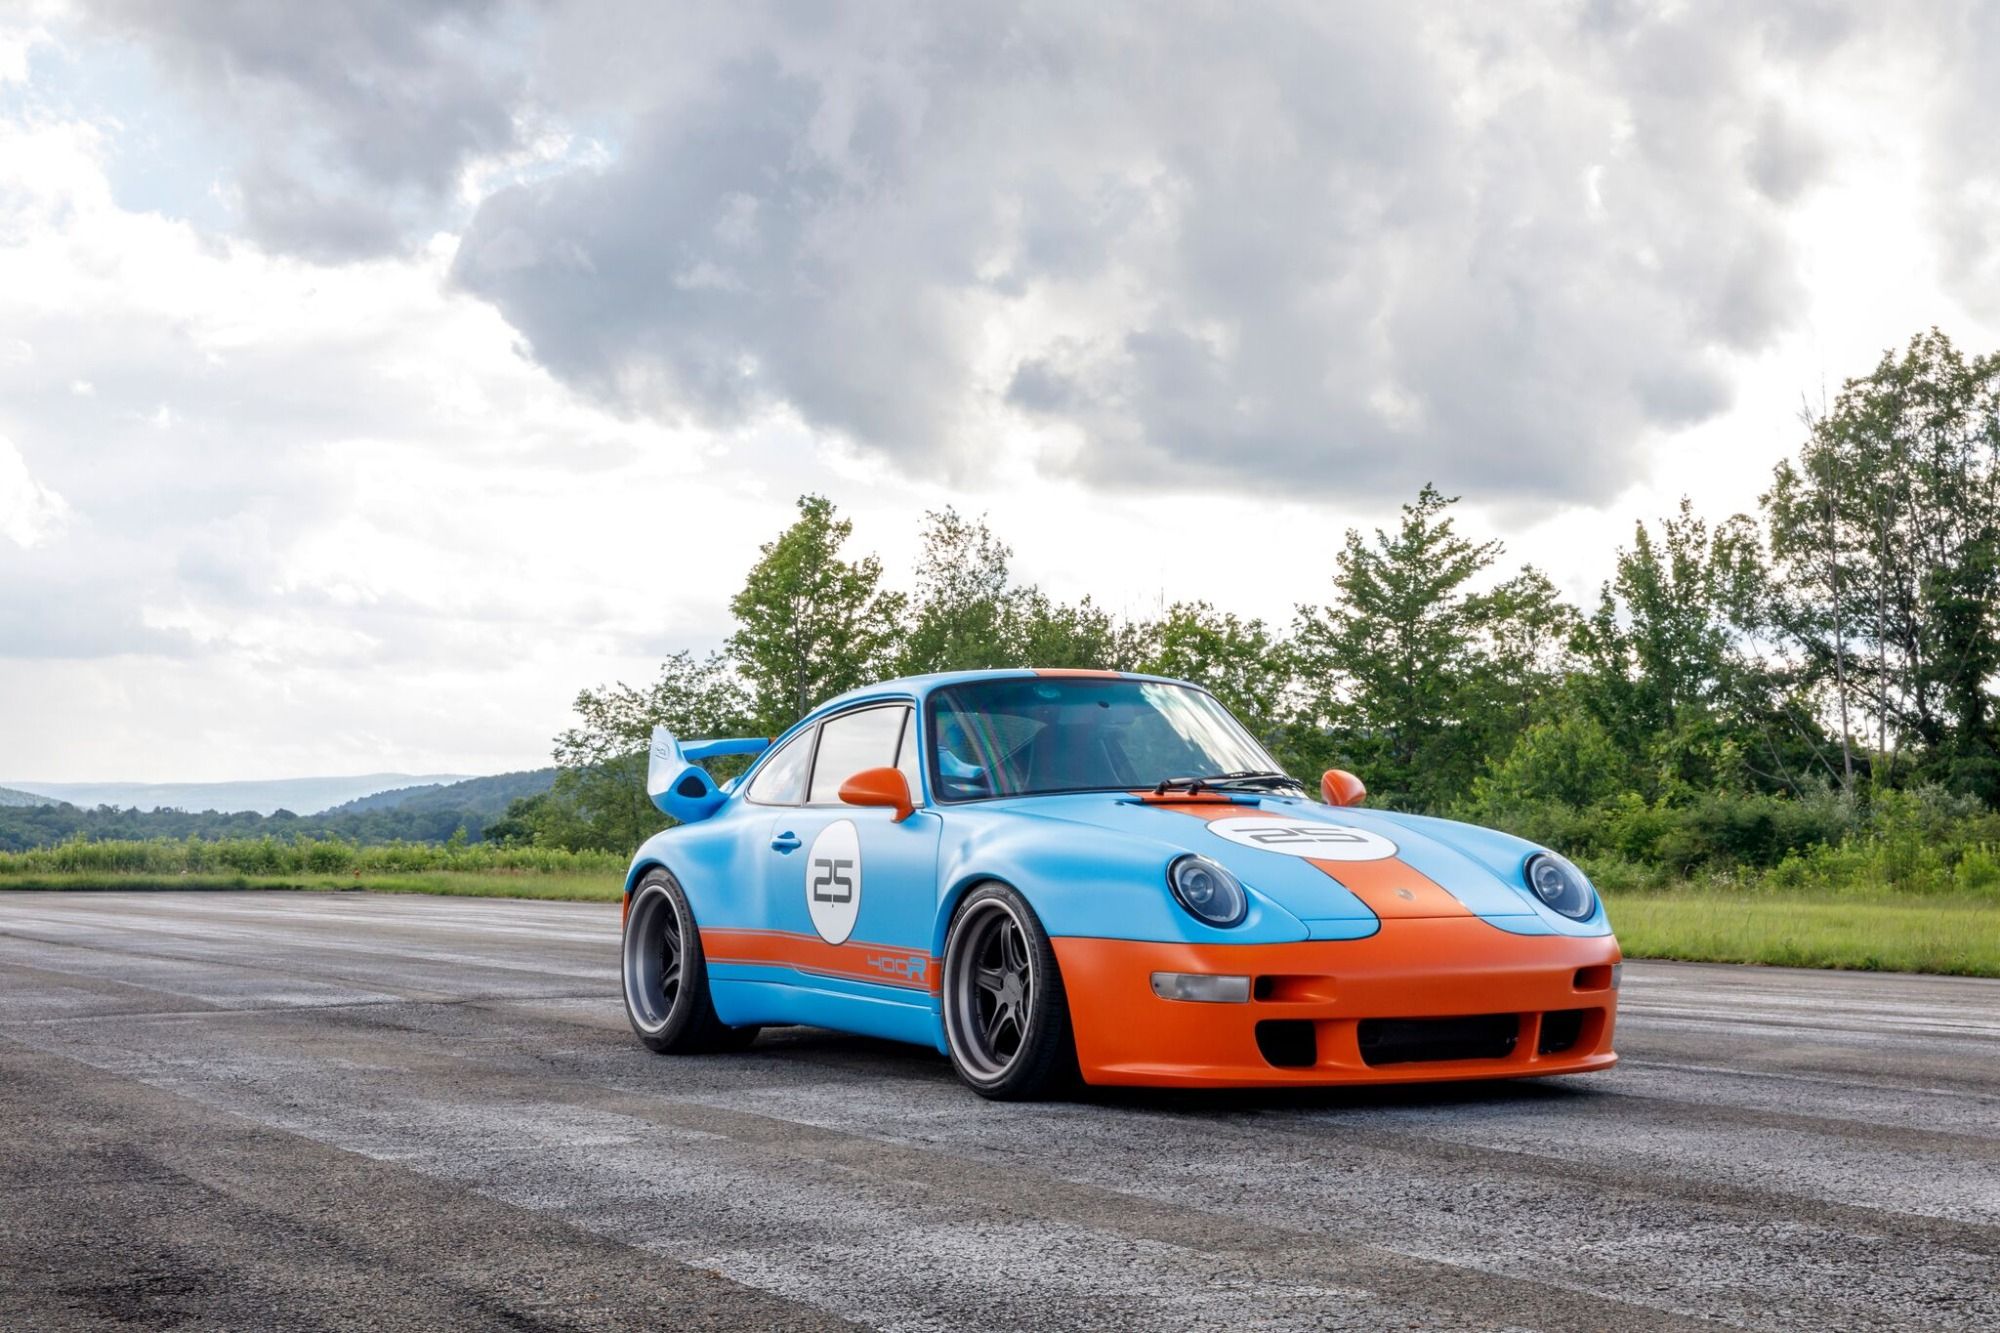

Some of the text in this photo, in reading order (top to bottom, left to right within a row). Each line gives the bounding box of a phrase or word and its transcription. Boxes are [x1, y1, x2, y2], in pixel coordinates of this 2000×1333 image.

[1232, 828, 1369, 844] 25
[814, 859, 853, 904] 25
[867, 953, 926, 981] 400R
